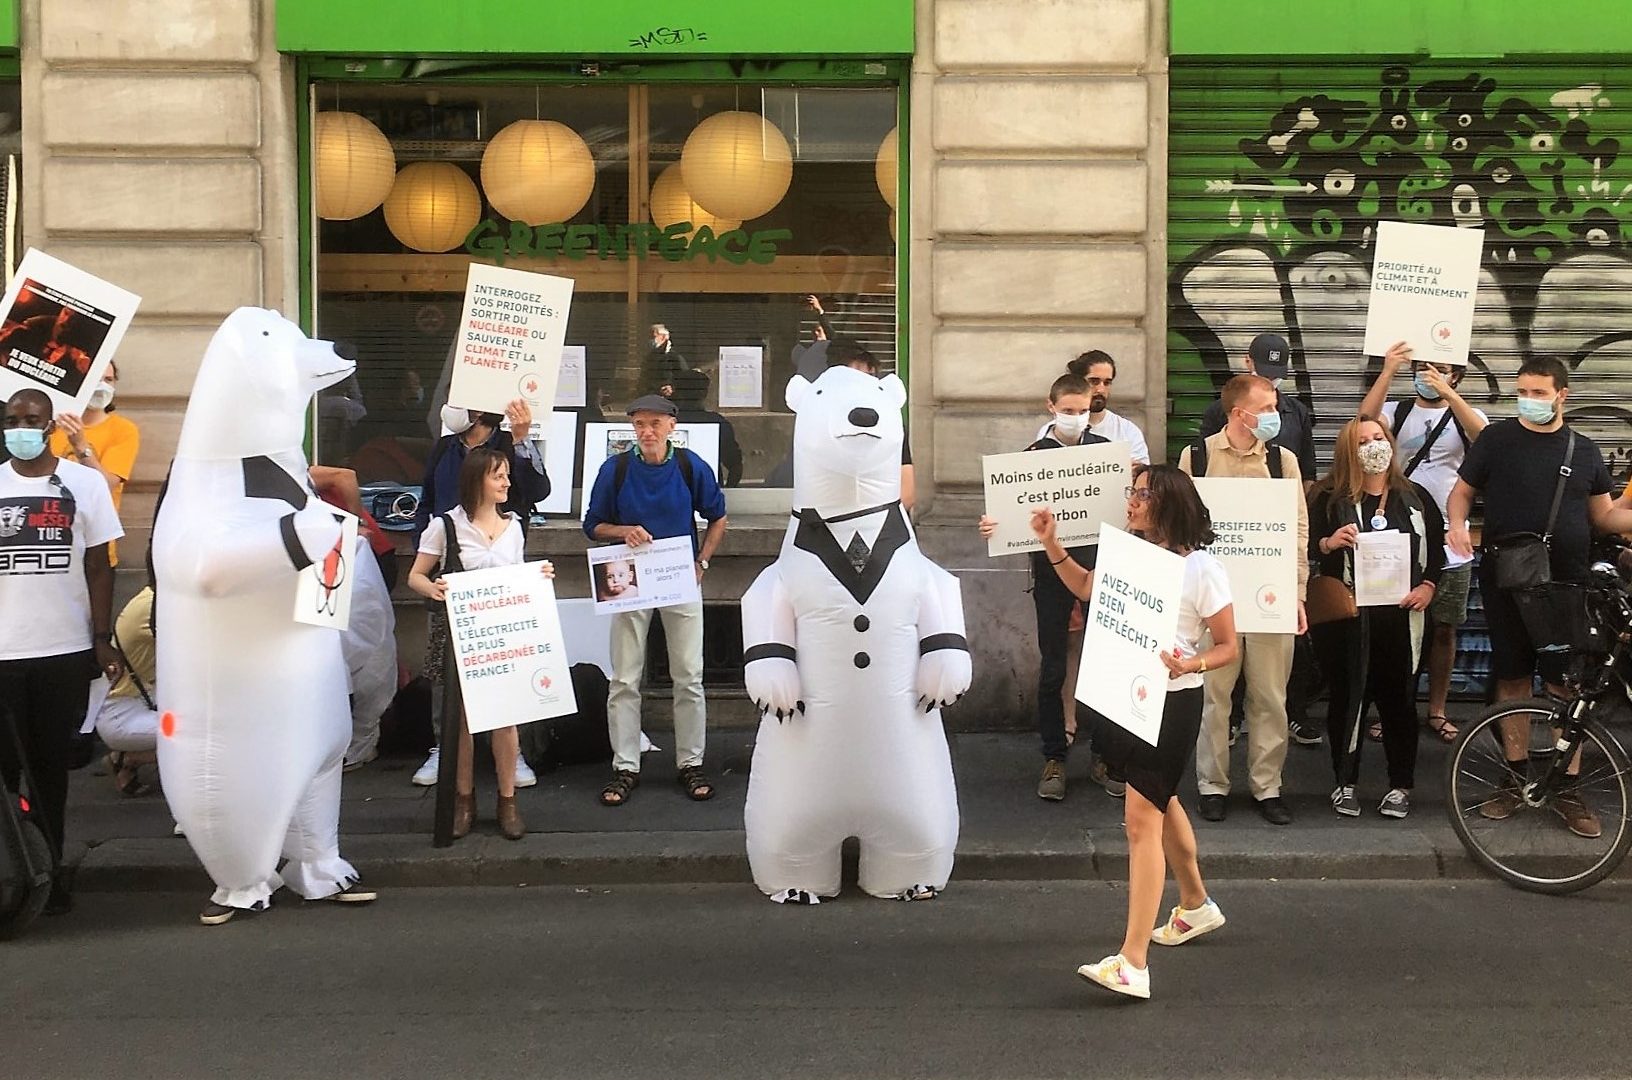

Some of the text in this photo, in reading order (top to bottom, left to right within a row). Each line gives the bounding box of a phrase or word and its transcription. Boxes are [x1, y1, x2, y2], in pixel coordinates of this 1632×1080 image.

[464, 218, 793, 265] GREENPEACE
[1378, 262, 1442, 275] PRIORITÉ AU
[1376, 272, 1414, 283] CLIMAT
[1416, 276, 1429, 284] ET
[474, 284, 541, 303] INTERROGEZ
[1375, 282, 1469, 299] L'ENVIRONNEMENT
[473, 296, 494, 307] VOS
[496, 300, 553, 317] PRIORITÉS
[471, 308, 528, 325] SORTIR DU
[468, 320, 546, 340] NUCLÉAIRE OU
[467, 332, 523, 348] SAUVER LE
[465, 343, 536, 362] CLIMAT ET LA
[463, 355, 509, 370] PLANÈTE
[990, 462, 1124, 485] Moins de nucléaire,
[1017, 485, 1100, 504] c'est plus de
[43, 500, 60, 512] LE
[1052, 509, 1088, 522] rbon
[37, 527, 63, 540] TUE
[1212, 521, 1286, 532] ERSIFIEZ VOS
[1216, 534, 1244, 543] RCES
[1207, 546, 1282, 556] NFORMATION
[451, 590, 474, 601] FUN
[476, 585, 504, 597] FACT
[1101, 573, 1164, 614] AVEZ-VOUS
[453, 594, 531, 615] LE NUCLÉAIRE
[1098, 591, 1125, 615] BIEN
[456, 616, 476, 627] EST
[458, 616, 539, 641] L'ÉLECTRICITÉ
[1096, 610, 1158, 652] RÉFLÉCHI ?
[460, 638, 506, 654] LA PLUS
[463, 643, 551, 667] DÉCARBONÉE DE
[465, 663, 509, 680] FRANCE
